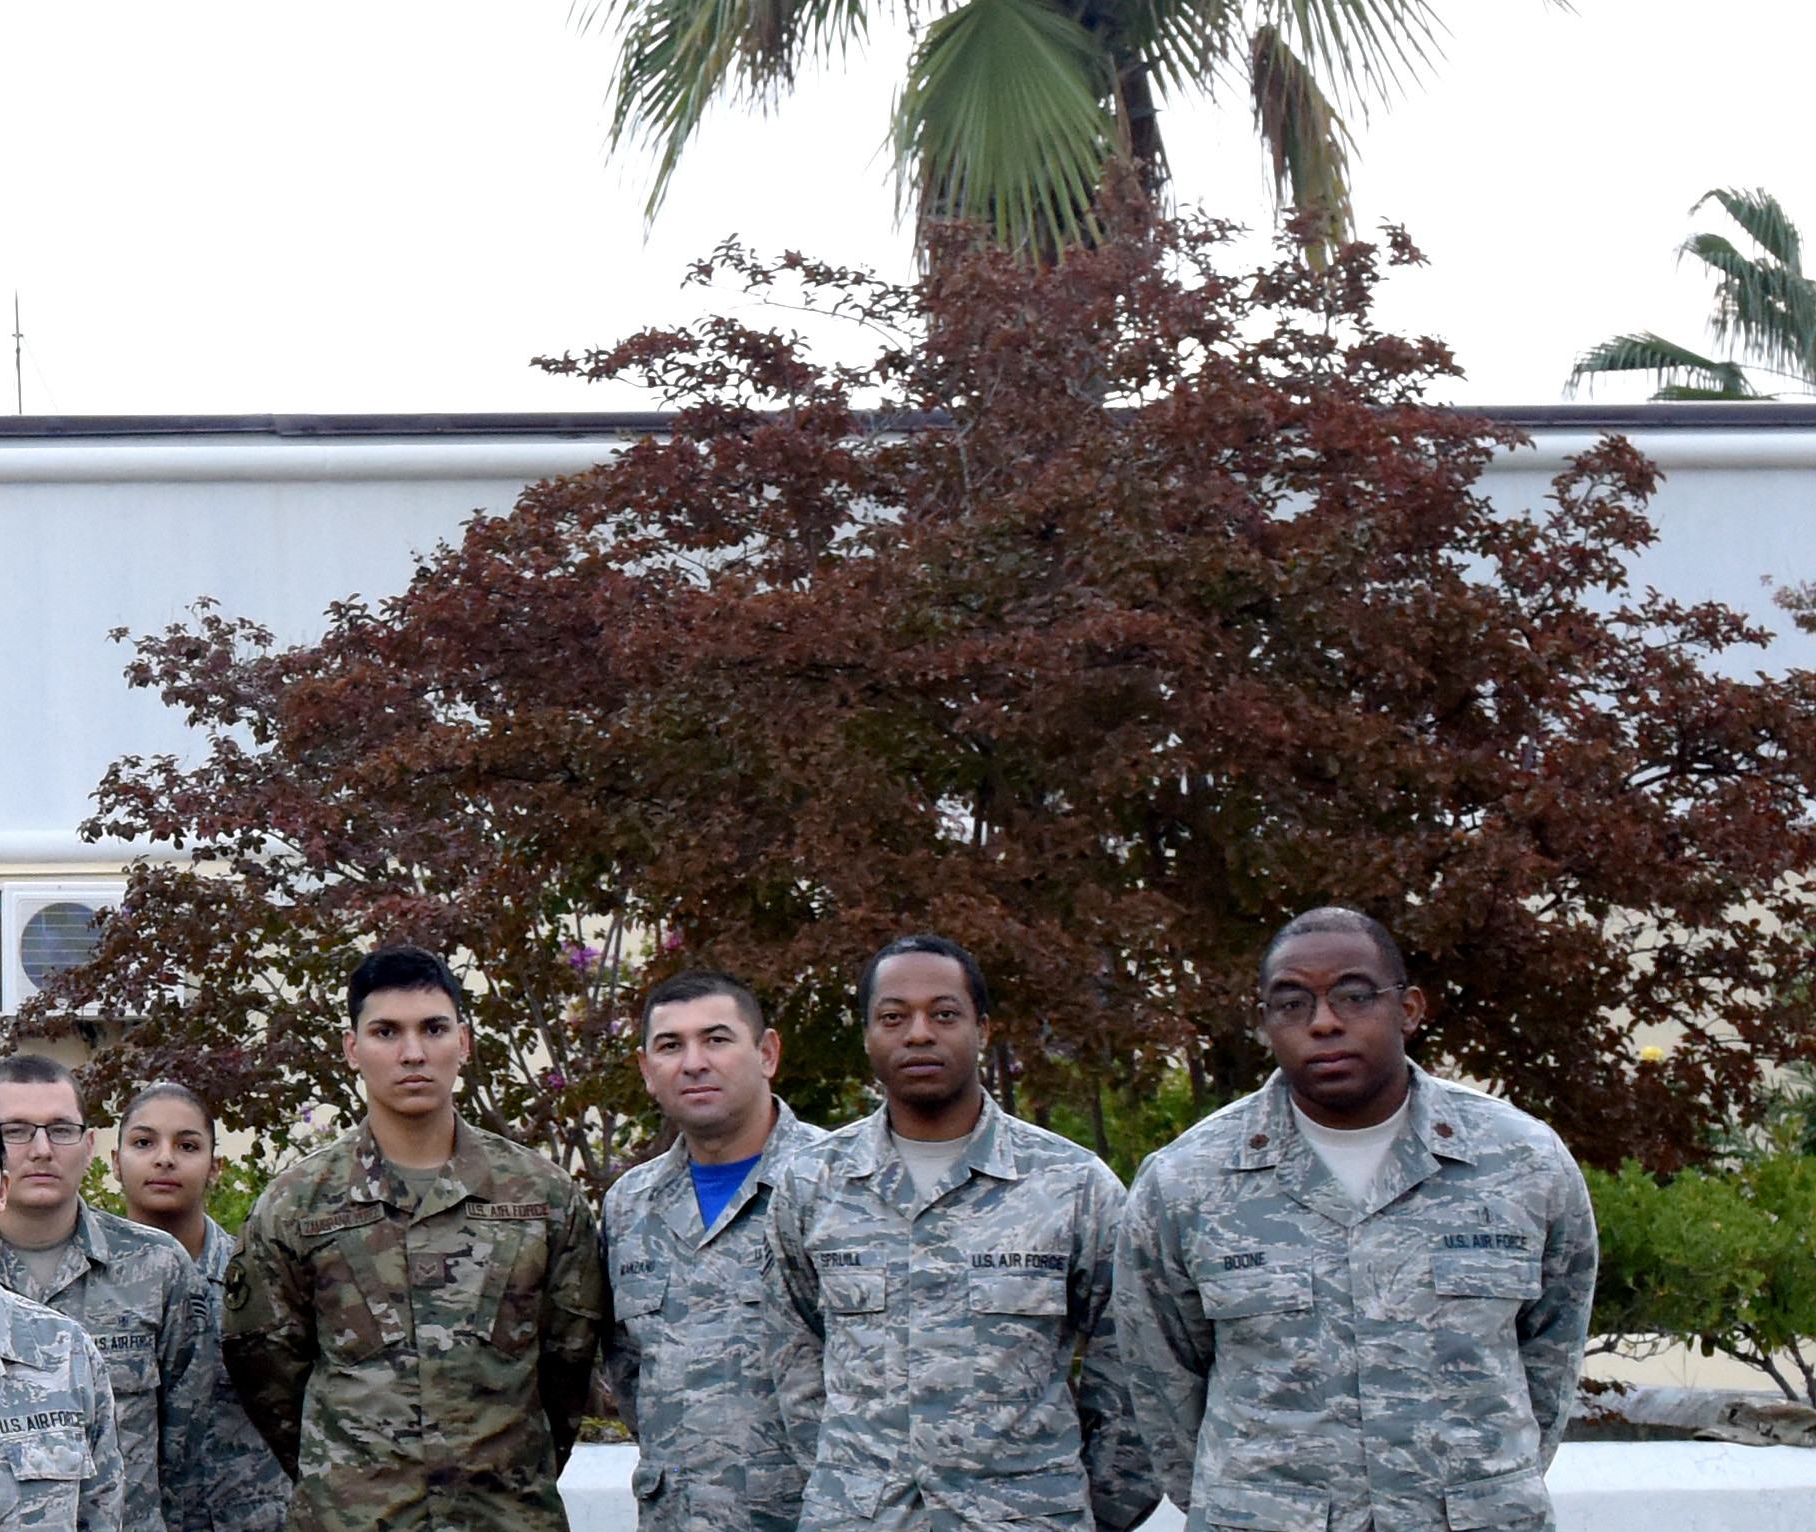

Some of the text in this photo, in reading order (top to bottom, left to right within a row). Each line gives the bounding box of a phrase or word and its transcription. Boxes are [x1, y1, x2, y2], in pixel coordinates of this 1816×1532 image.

[1472, 1234, 1493, 1248] AIR
[1496, 1233, 1528, 1250] FORCE
[998, 1252, 1022, 1268] AIR
[1024, 1253, 1065, 1271] FORCE
[1223, 1252, 1266, 1271] BOONE
[111, 1336, 128, 1350] AIR
[25, 1414, 50, 1431] AIR
[50, 1410, 85, 1428] FORCE
